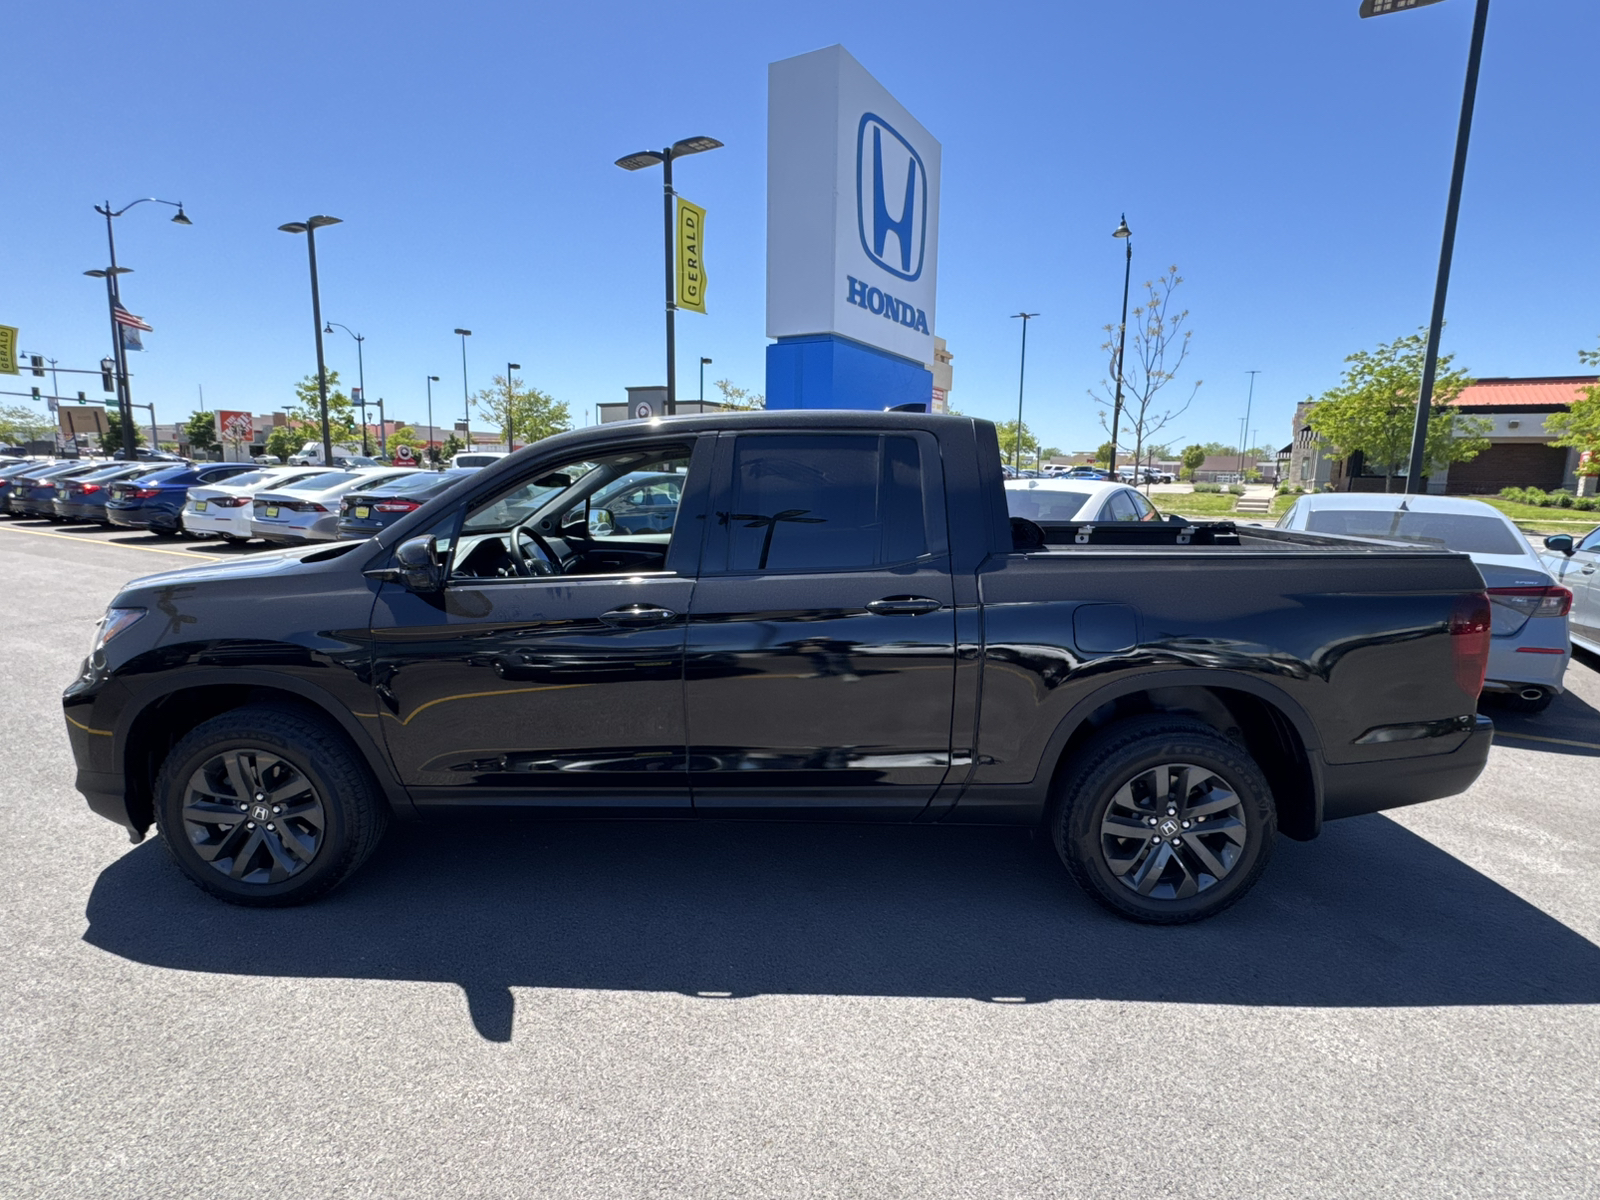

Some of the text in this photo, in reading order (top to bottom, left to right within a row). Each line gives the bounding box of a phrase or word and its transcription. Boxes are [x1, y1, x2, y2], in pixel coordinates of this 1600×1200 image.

[686, 217, 698, 297] GERALD
[846, 274, 930, 336] HONDA
[0, 331, 9, 369] GERALD
